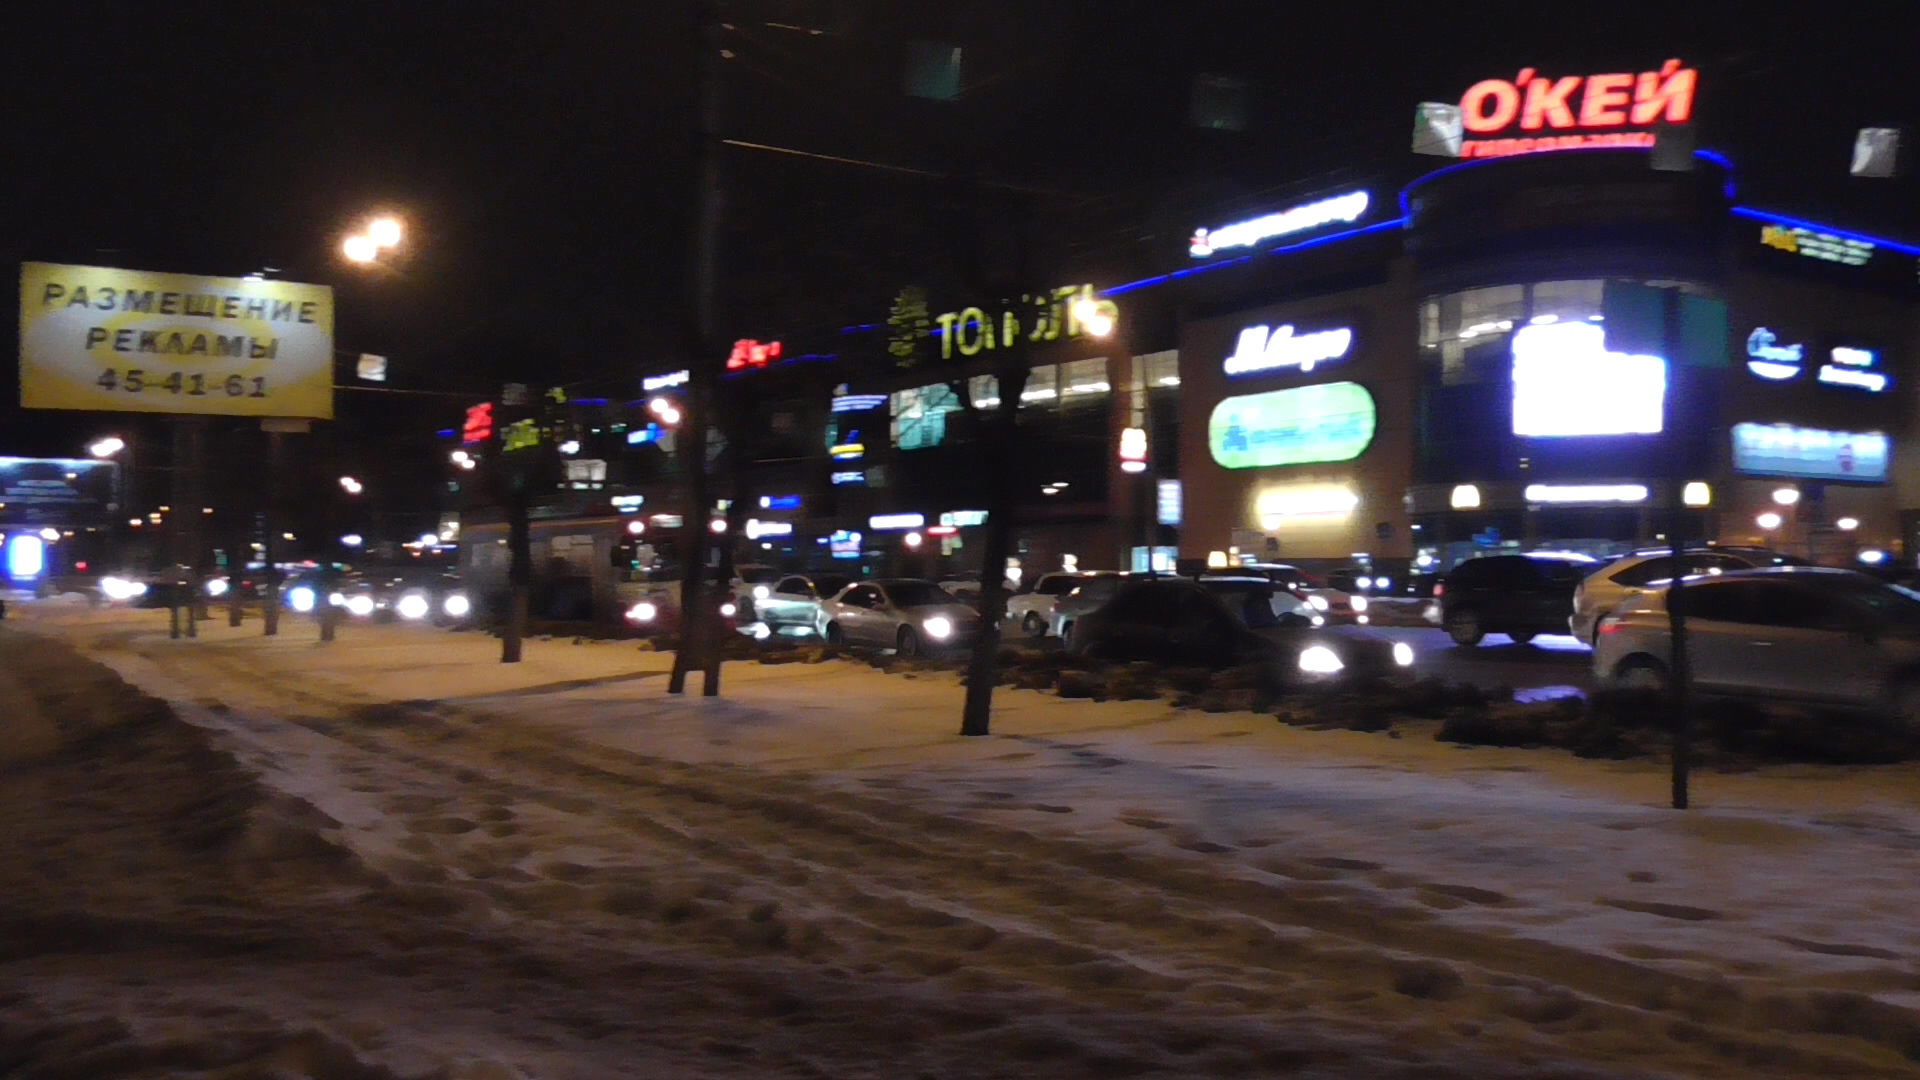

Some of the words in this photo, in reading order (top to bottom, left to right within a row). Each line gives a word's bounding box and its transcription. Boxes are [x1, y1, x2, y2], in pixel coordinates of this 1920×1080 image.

[43, 282, 320, 324] РАЗМЕЩЕНИЕ
[85, 327, 278, 360] РЕКЛАМЫ
[97, 368, 267, 398] 45-41-61
